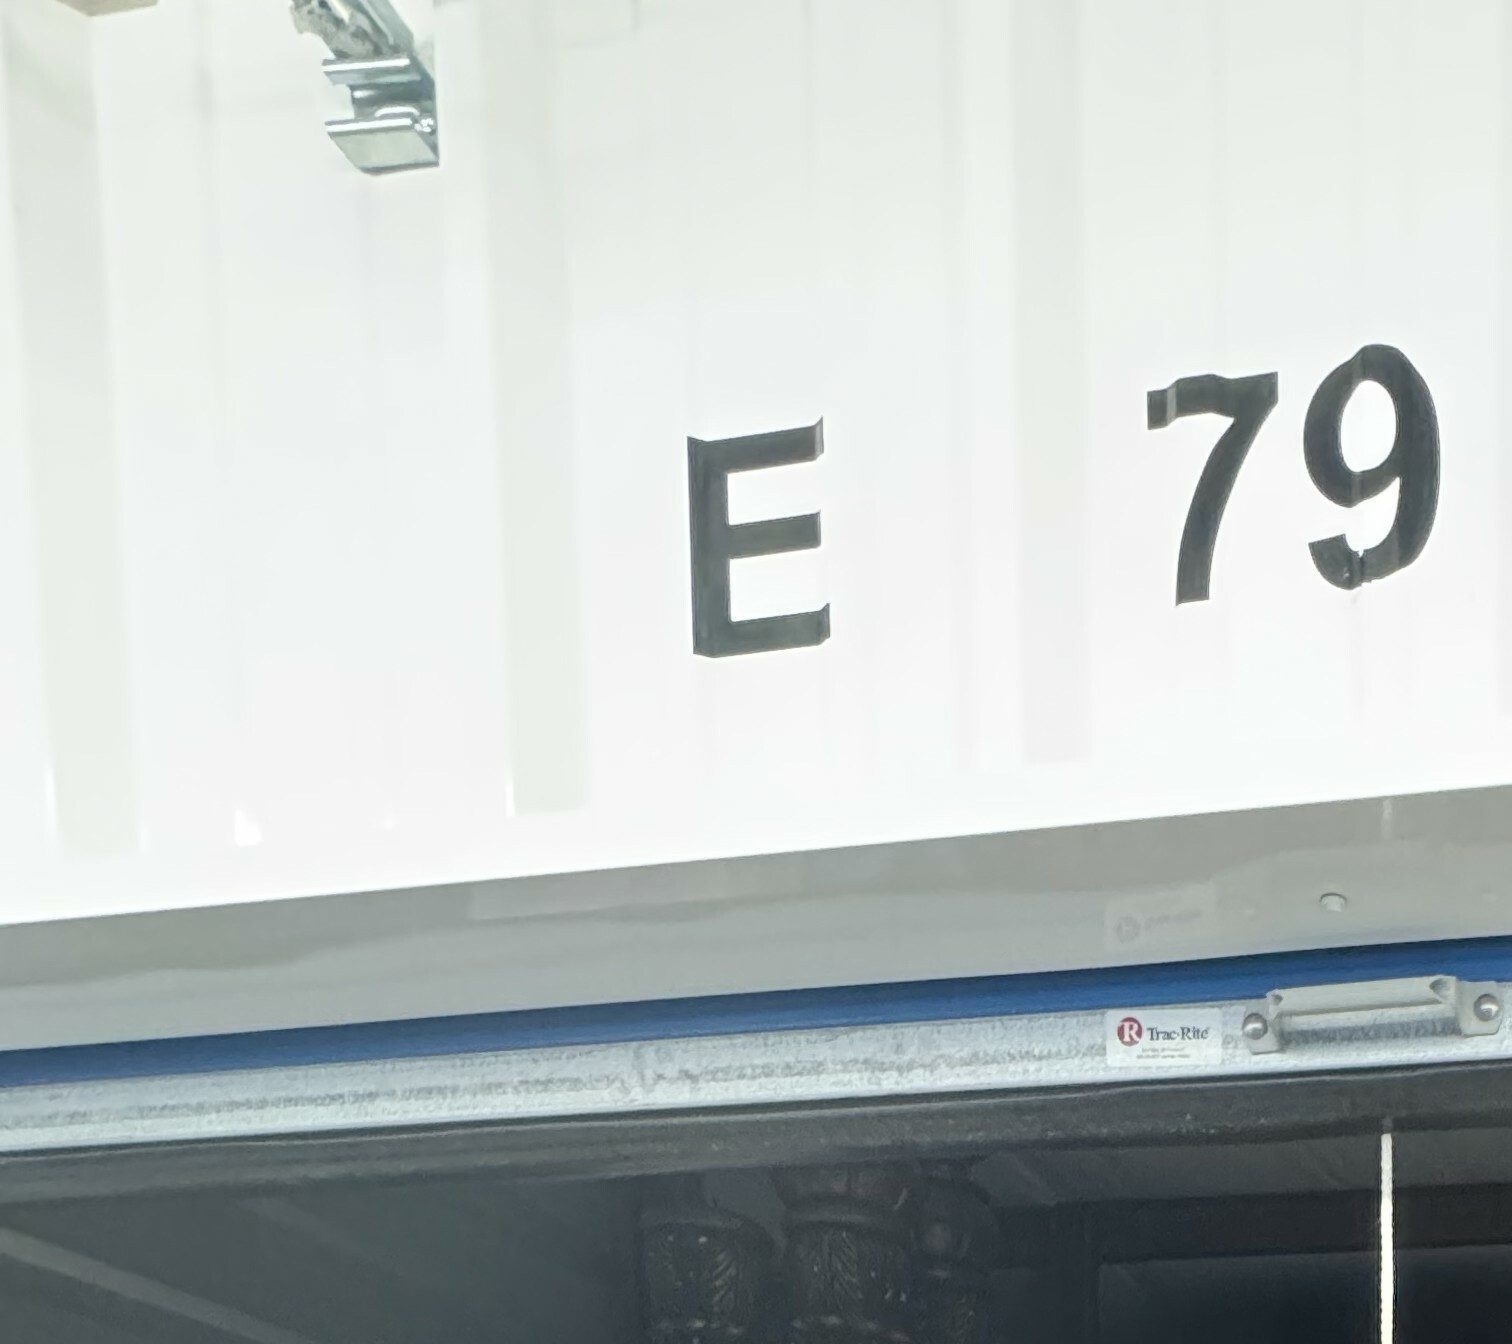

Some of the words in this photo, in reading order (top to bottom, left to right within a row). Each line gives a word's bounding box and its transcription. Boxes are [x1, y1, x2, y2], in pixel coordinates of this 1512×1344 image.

[687, 416, 831, 659] E
[1147, 343, 1441, 607] 79
[1118, 1020, 1141, 1043] R
